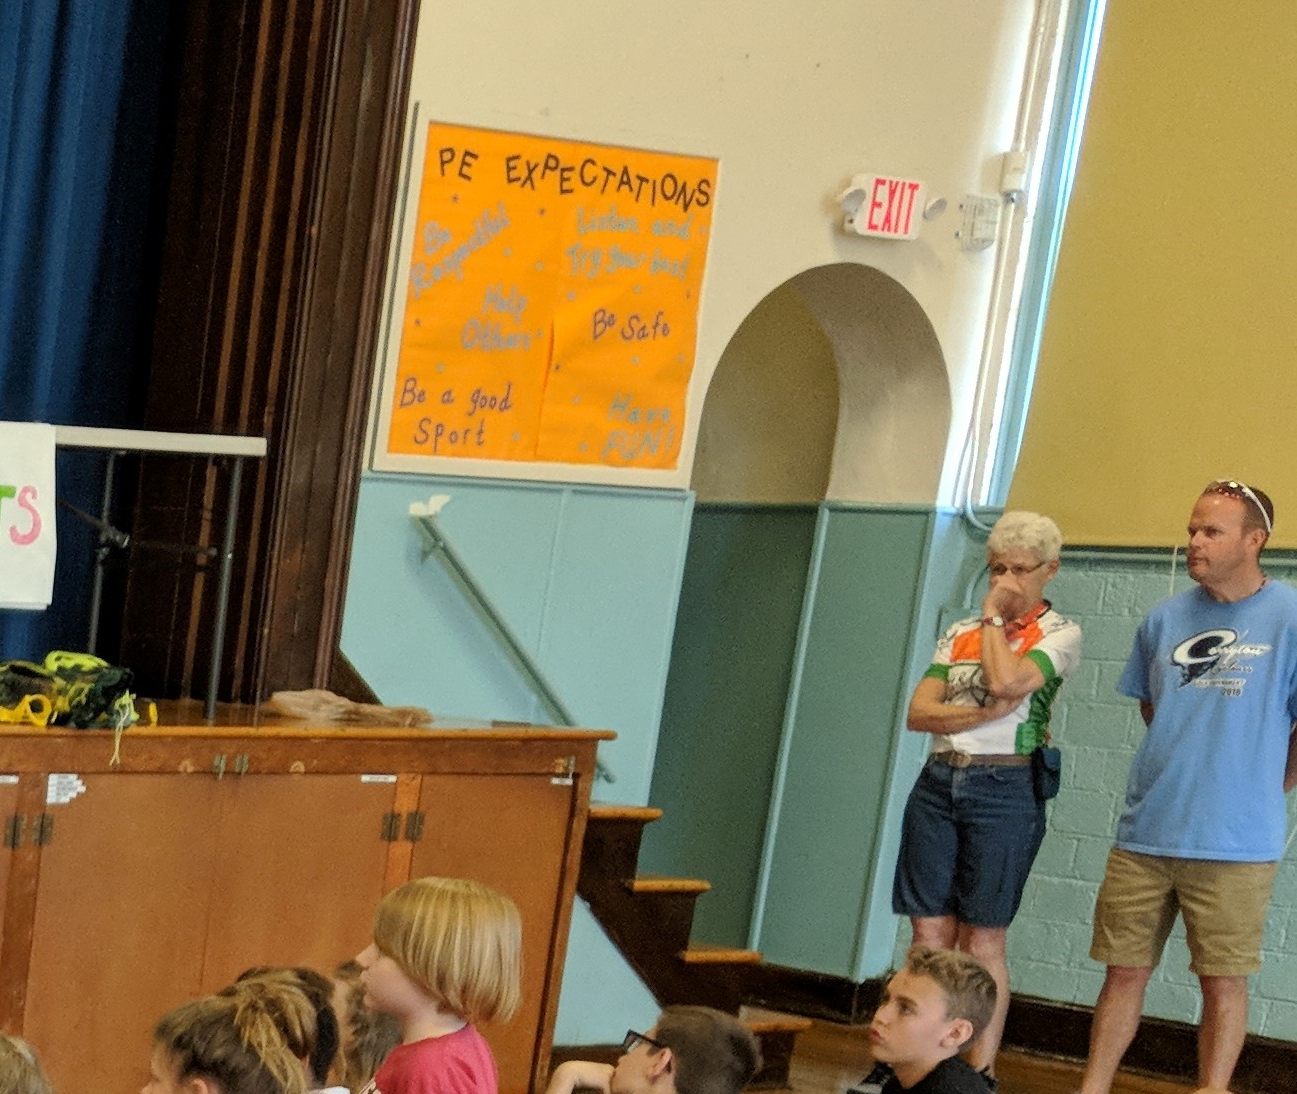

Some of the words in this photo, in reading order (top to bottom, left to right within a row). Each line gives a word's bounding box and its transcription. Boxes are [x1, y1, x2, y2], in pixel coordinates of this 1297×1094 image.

[439, 147, 479, 181] PE
[505, 153, 712, 212] EXPECTATIONS
[867, 178, 920, 235] EXIT
[652, 210, 695, 241] and
[566, 241, 603, 279] Try
[481, 280, 529, 325] Help
[460, 317, 532, 352] Others
[592, 308, 616, 340] Be
[621, 311, 670, 341] Safe
[400, 377, 426, 407] Be
[441, 389, 455, 404] a
[467, 381, 512, 416] good
[608, 391, 671, 424] Have
[414, 417, 485, 453] Sport
